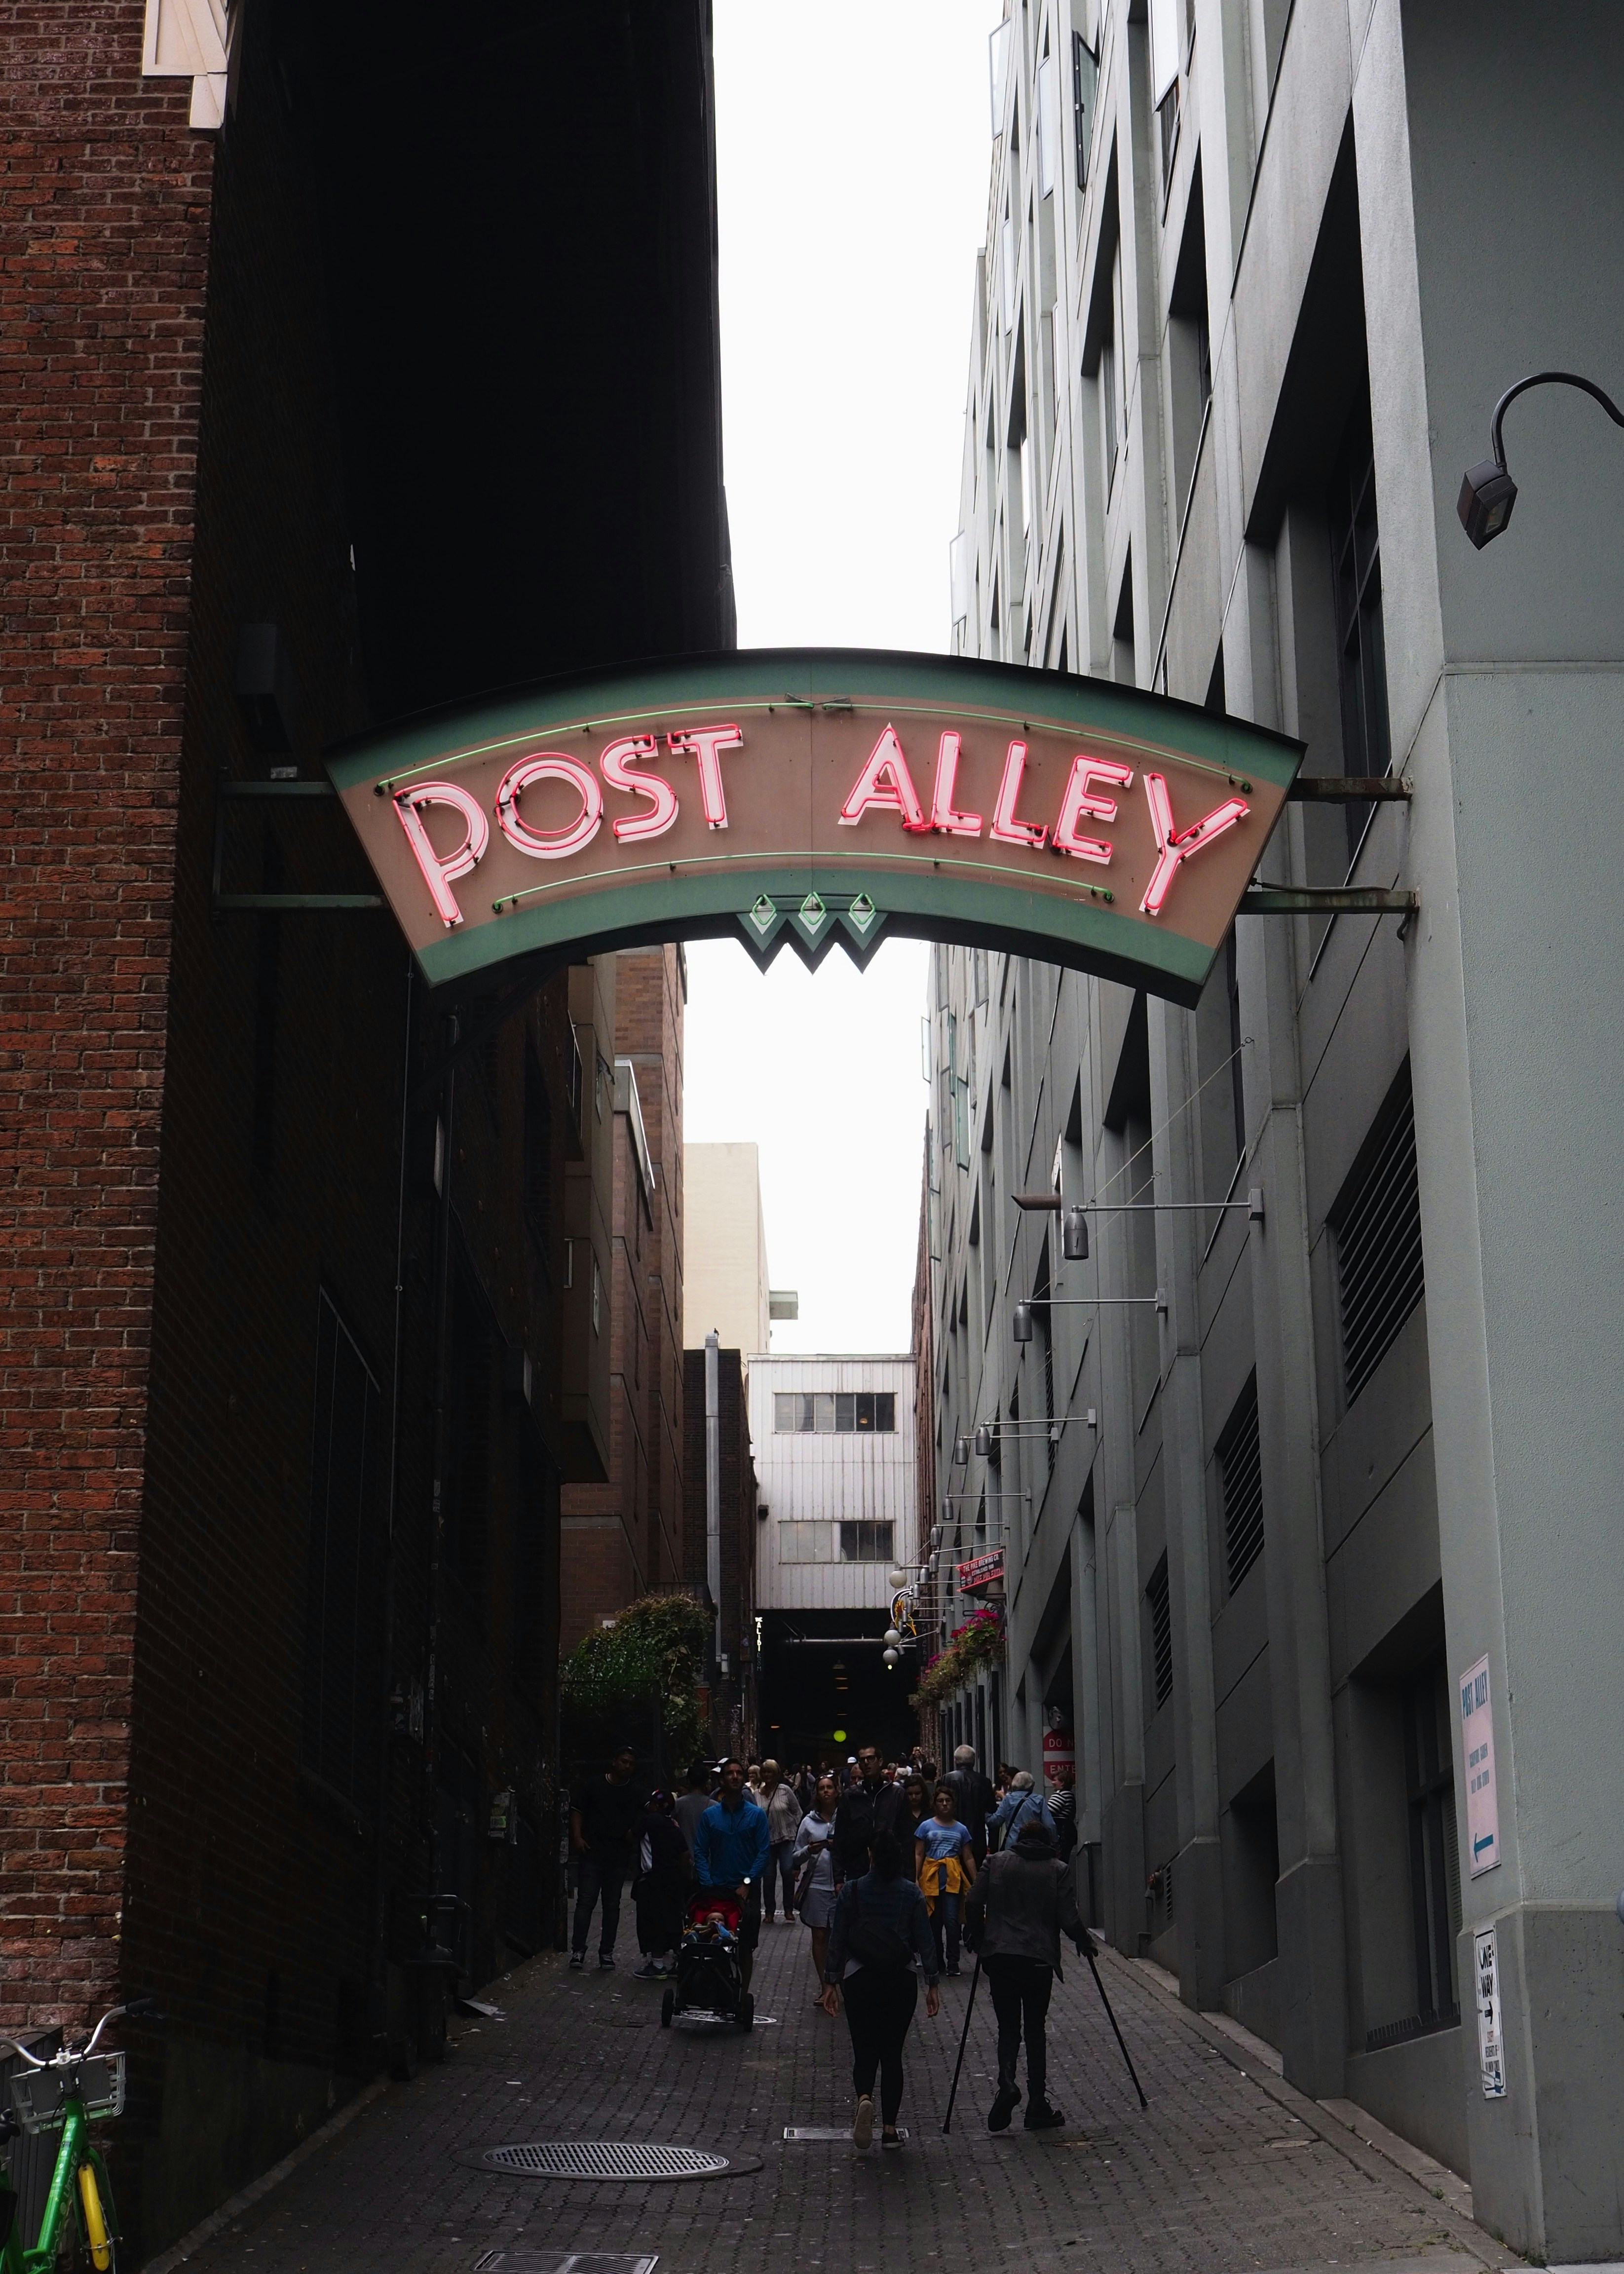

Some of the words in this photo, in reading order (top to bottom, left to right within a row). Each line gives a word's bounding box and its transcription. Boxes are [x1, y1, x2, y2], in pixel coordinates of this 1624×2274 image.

[393, 723, 742, 928] POST
[838, 722, 1250, 916] ALLEY
[1462, 1682, 1473, 1719] POST
[1474, 1669, 1488, 1709] ALLEY
[1049, 1739, 1062, 1747] DO
[1050, 1765, 1076, 1774] ENTE
[1481, 1973, 1493, 1998] WAY
